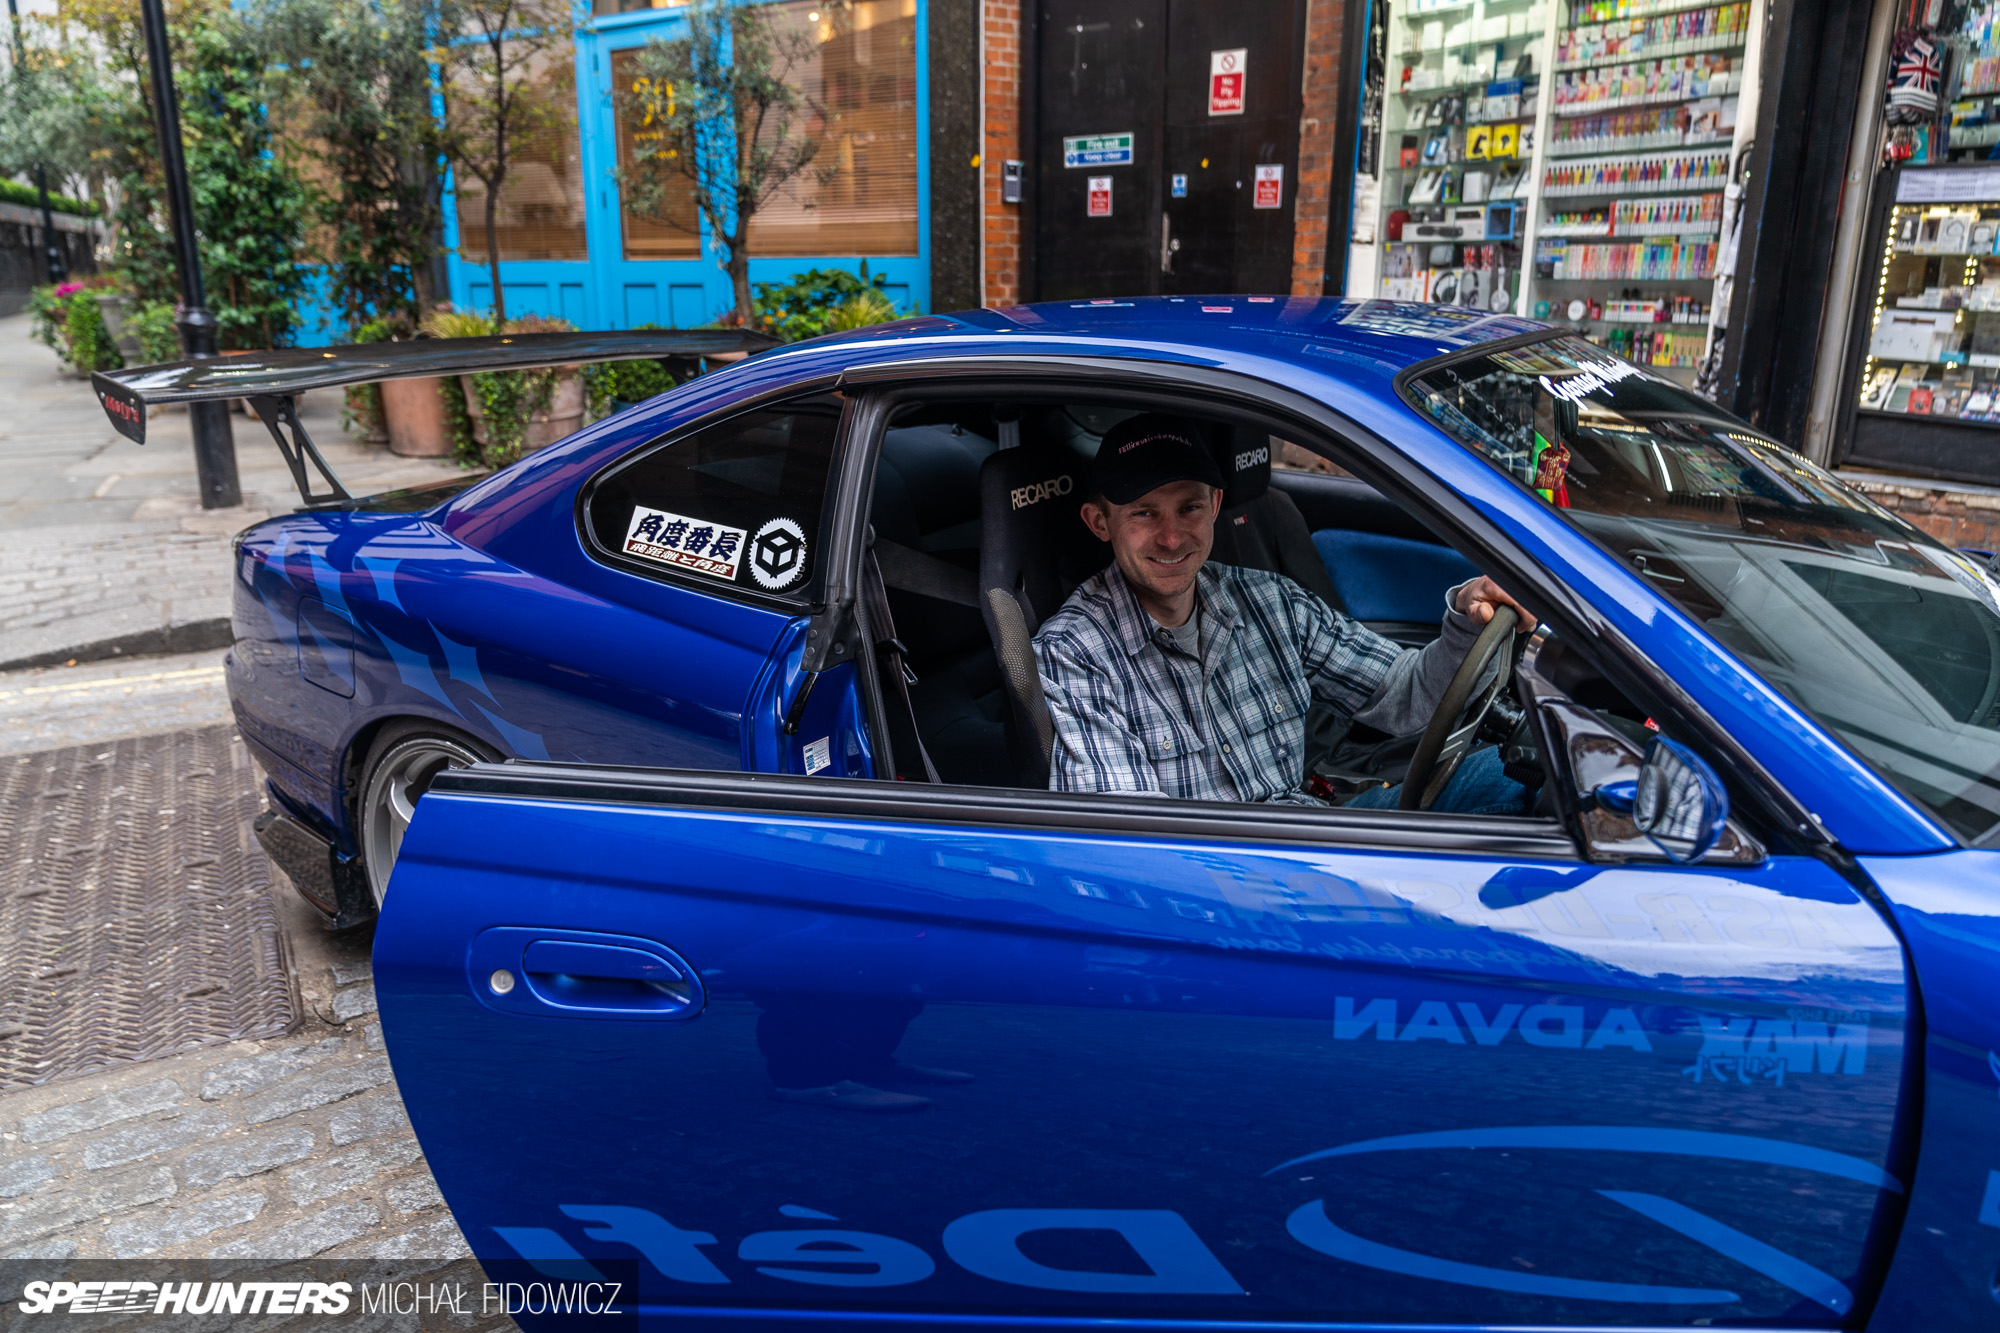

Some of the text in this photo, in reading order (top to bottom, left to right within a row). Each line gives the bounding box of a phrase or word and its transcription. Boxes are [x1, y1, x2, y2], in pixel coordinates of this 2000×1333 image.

[1087, 140, 1102, 149] Fire
[1235, 447, 1269, 471] RECARO
[1011, 475, 1073, 510] RECARO
[632, 512, 742, 561] 角度番長
